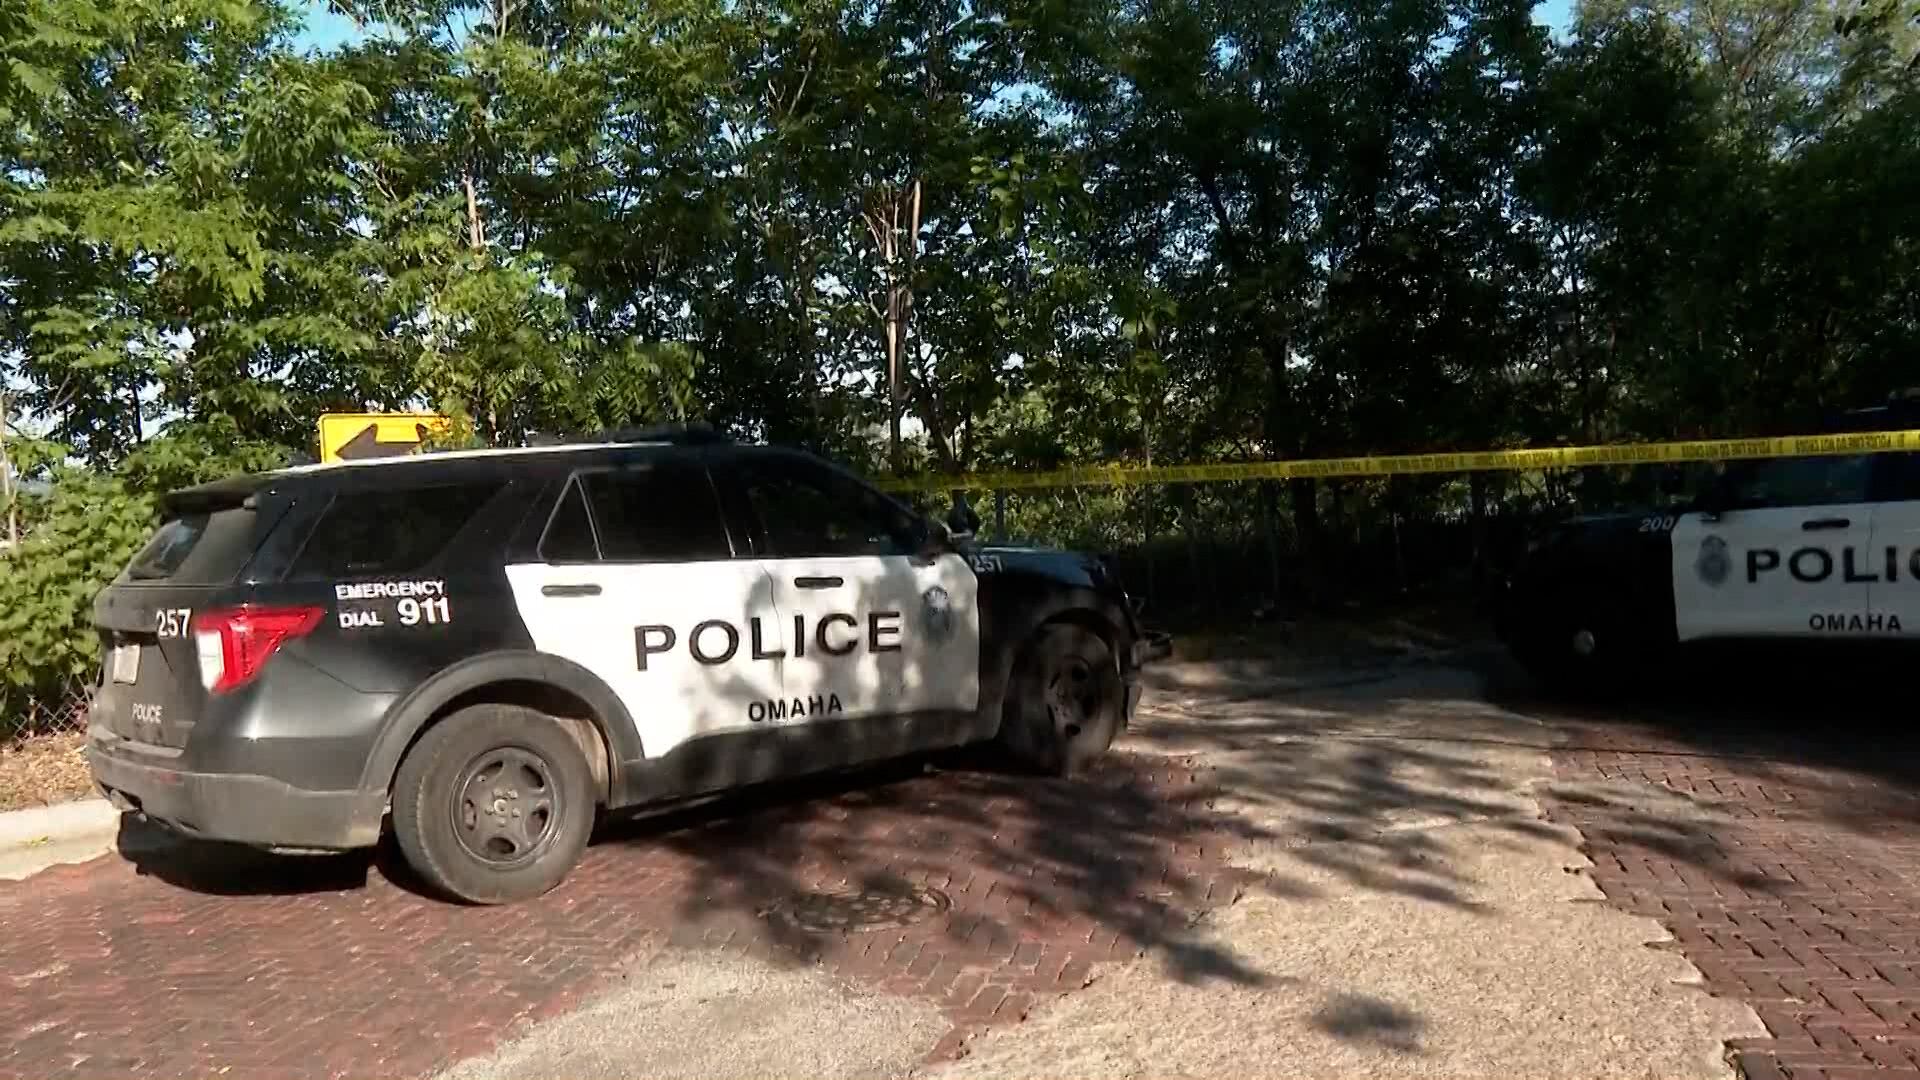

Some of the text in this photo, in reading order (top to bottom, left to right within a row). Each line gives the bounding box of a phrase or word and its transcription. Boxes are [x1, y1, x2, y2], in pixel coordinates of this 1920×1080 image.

[1638, 515, 1675, 532] 200
[1746, 546, 1920, 583] POLI
[335, 581, 444, 600] EMERGENCY
[156, 608, 191, 638] 257
[340, 598, 450, 629] DIAL 911
[1809, 613, 1901, 632] OMAHA
[634, 611, 902, 672] POLICE
[132, 703, 163, 724] POLICE
[748, 693, 843, 723] OMAHA
